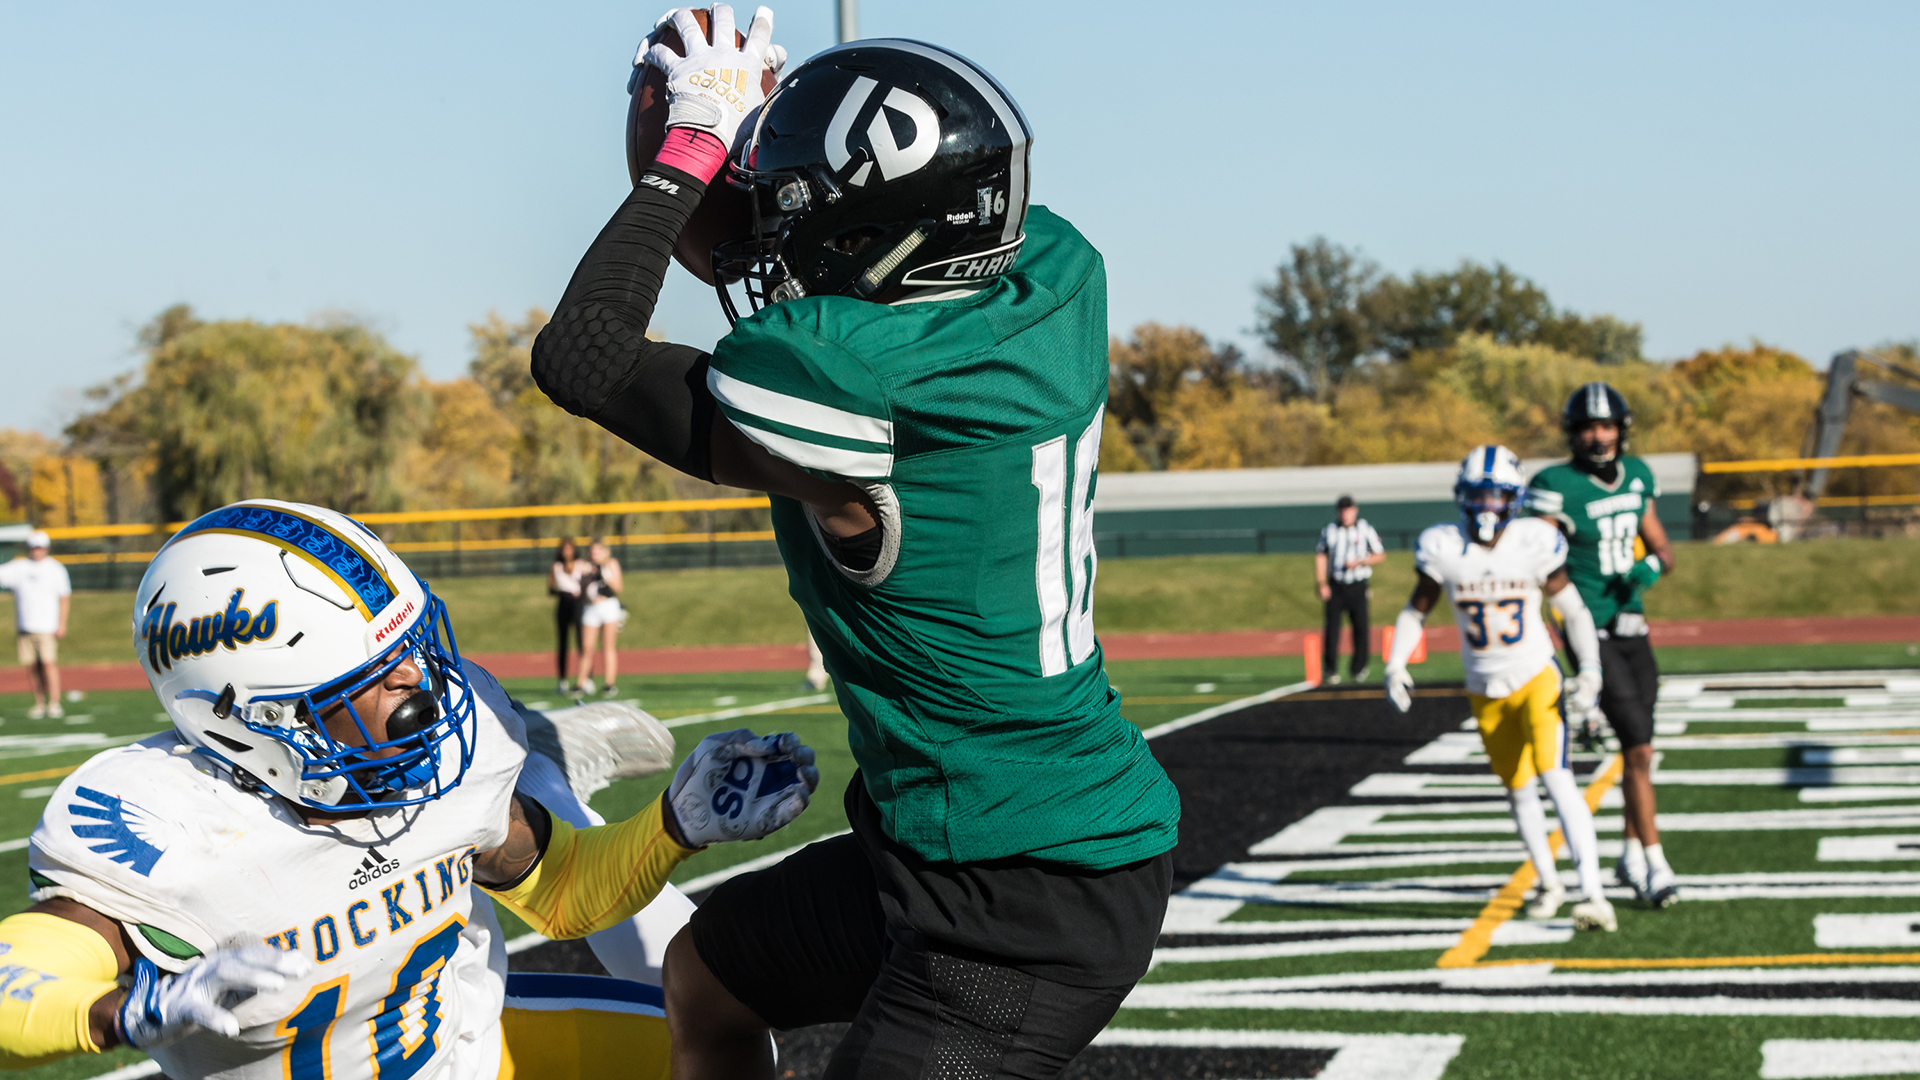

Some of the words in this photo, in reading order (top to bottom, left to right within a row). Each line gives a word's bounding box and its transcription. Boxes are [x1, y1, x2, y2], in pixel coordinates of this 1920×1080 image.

[689, 74, 746, 112] adidas
[306, 535, 331, 552] Ohio
[1031, 402, 1104, 678] 16
[1597, 511, 1639, 575] 10
[337, 556, 360, 575] Ohio
[363, 583, 385, 604] Ohio
[141, 587, 279, 675] Hawks
[375, 600, 414, 642] Riddell
[1457, 597, 1526, 651] 33
[348, 858, 400, 890] adidas
[274, 911, 468, 1080] 10
